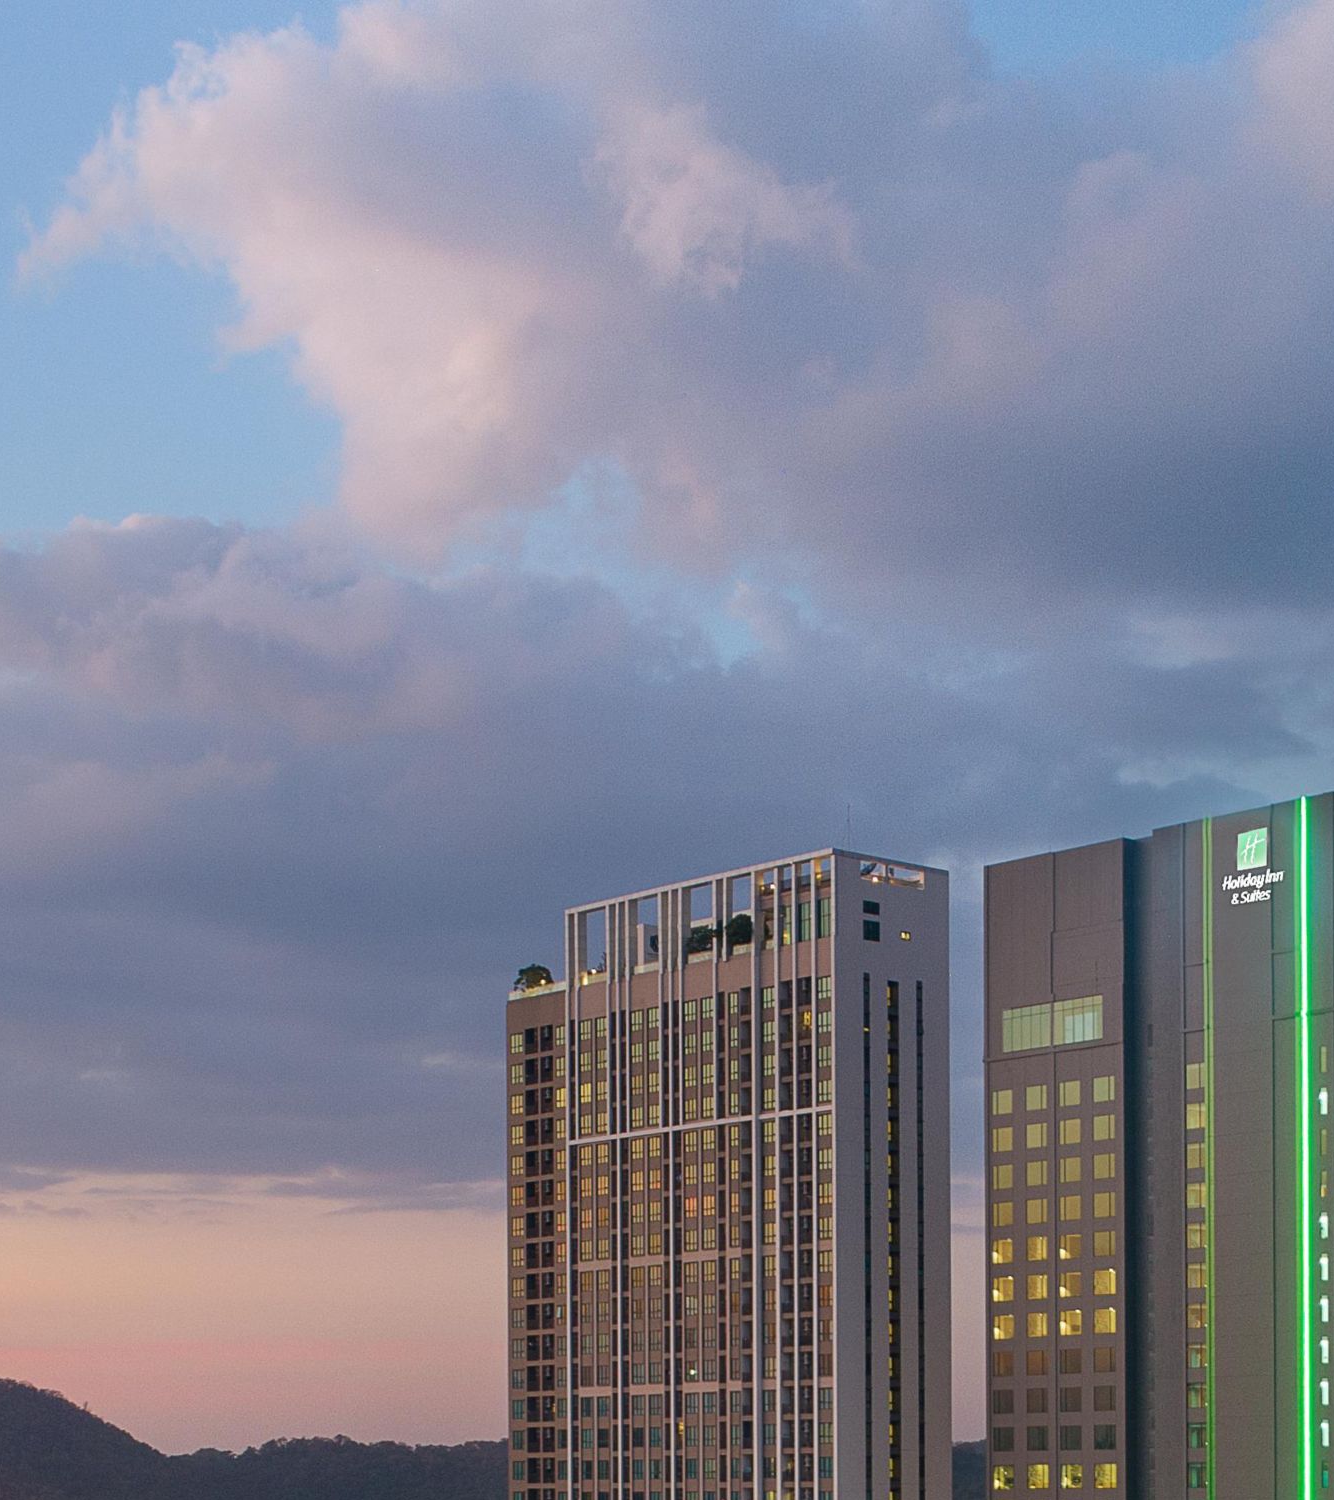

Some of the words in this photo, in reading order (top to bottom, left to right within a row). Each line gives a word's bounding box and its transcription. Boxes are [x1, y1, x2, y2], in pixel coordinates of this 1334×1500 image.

[1222, 873, 1265, 891] Holiday
[1265, 868, 1285, 884] Inn
[1231, 893, 1239, 904] &
[1240, 889, 1271, 904] Suites
